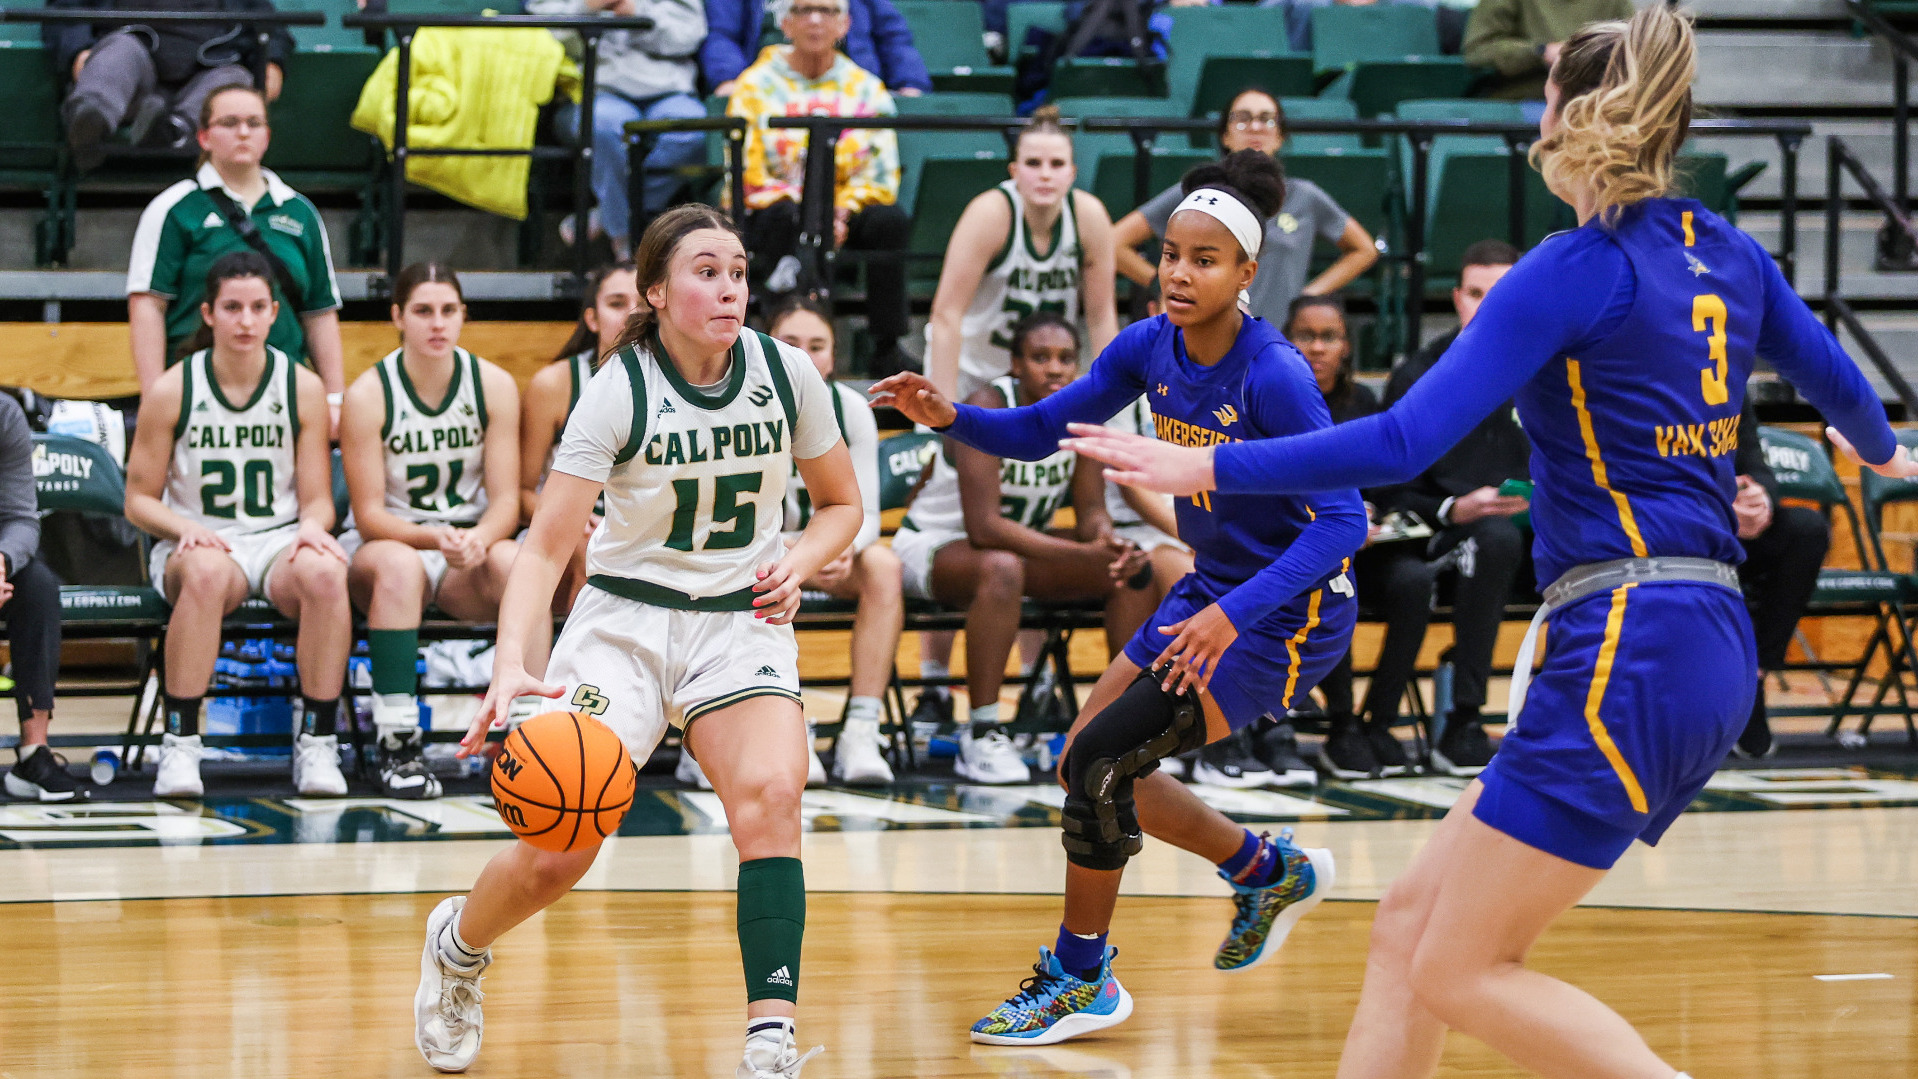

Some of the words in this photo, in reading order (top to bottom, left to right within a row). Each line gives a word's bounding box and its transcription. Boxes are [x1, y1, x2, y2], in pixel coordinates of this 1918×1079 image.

[1692, 294, 1729, 406] 3
[189, 425, 230, 448] CAL
[235, 424, 284, 448] POLY
[389, 430, 429, 454] CAL
[645, 431, 707, 465] CAL
[712, 419, 783, 460] POLY
[46, 453, 93, 479] POLY
[200, 459, 275, 519] 20
[406, 459, 466, 512] 21
[663, 471, 764, 552] 15
[766, 975, 793, 987] adidas
